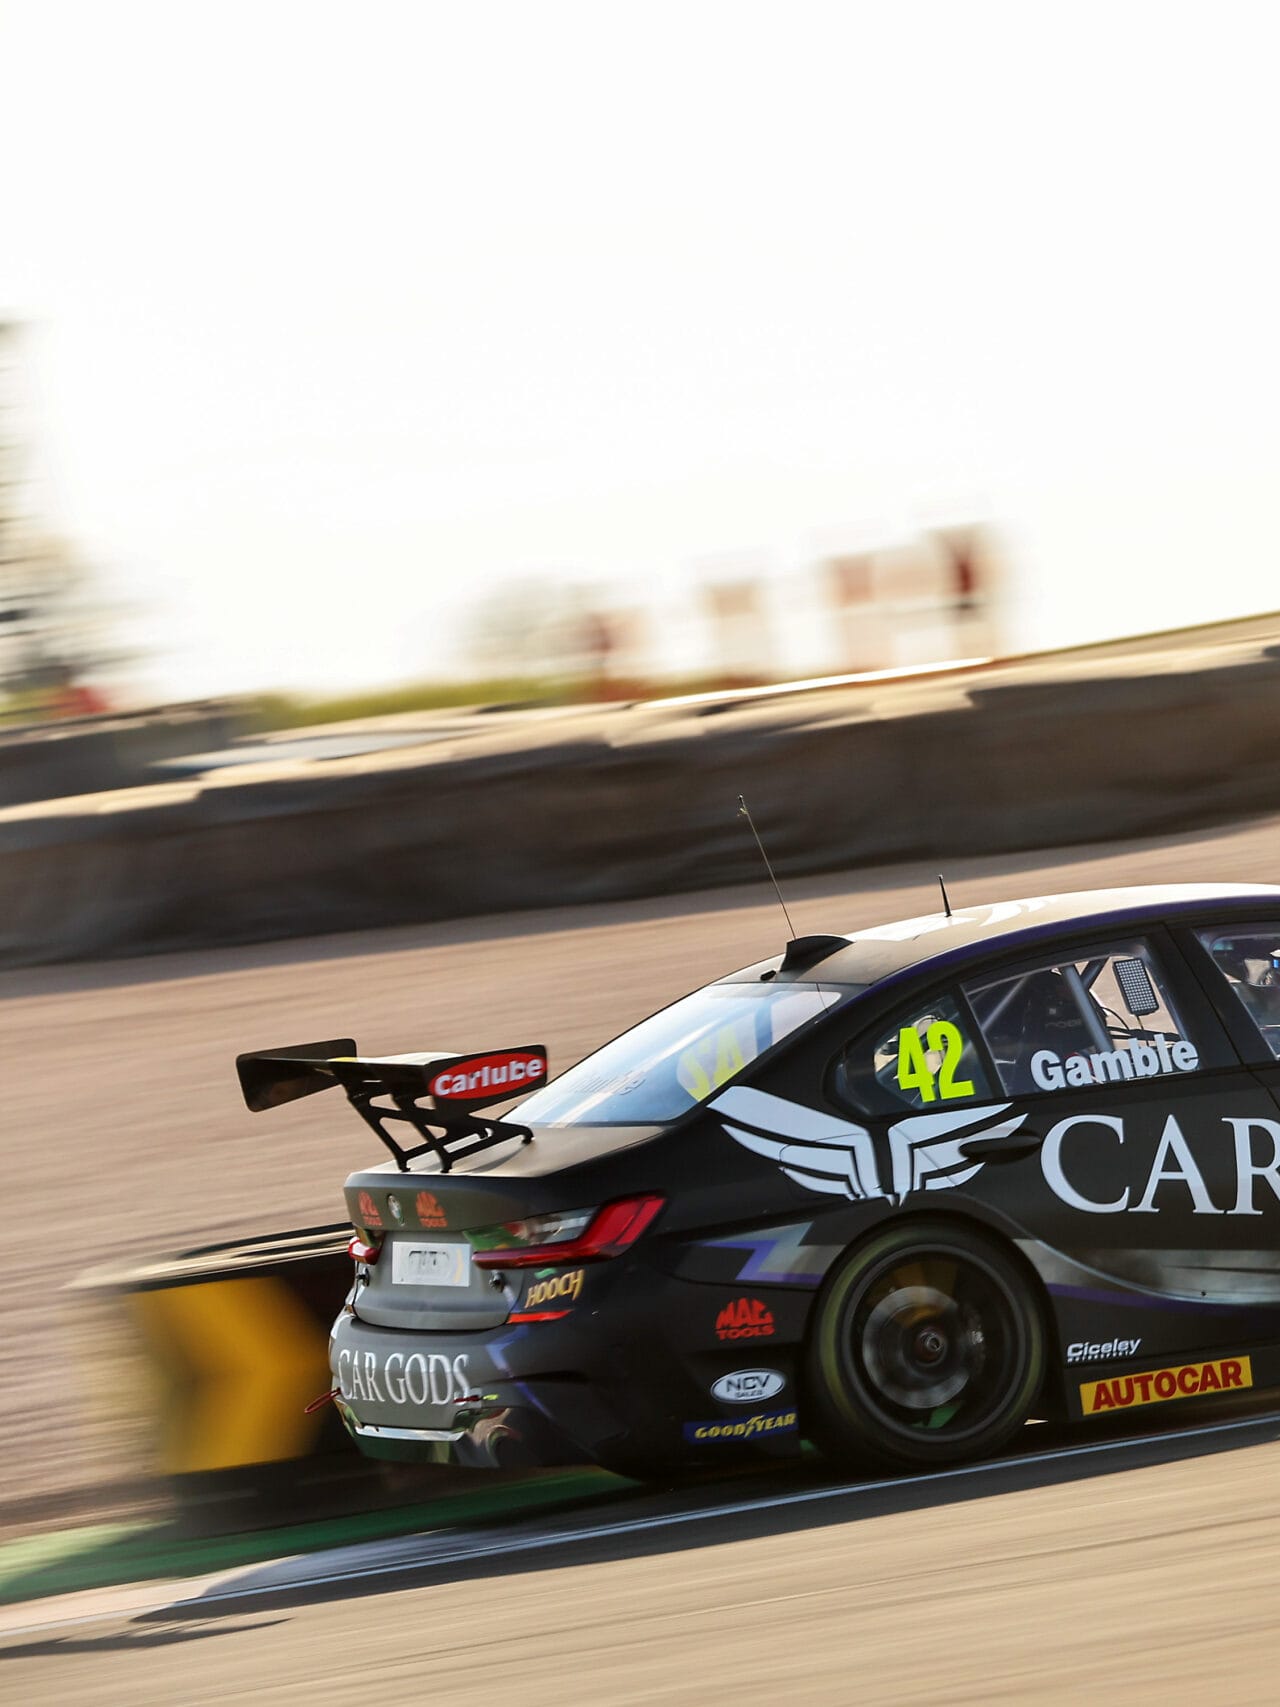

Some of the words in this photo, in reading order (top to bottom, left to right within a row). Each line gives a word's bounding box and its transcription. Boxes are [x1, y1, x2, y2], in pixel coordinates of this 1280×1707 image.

[435, 1059, 543, 1096] Carlube
[898, 1021, 975, 1103] 42
[1031, 1034, 1198, 1090] Gamble
[524, 1269, 585, 1309] HOOCH
[716, 1298, 774, 1329] MAC
[716, 1325, 776, 1341] TOOLS
[1067, 1338, 1142, 1358] Ciceley
[338, 1350, 385, 1402] CAR
[385, 1353, 472, 1406] GODS
[726, 1375, 770, 1392] NCV
[1092, 1360, 1244, 1411] AUTOCAR
[695, 1413, 797, 1438] GOODYEAR
